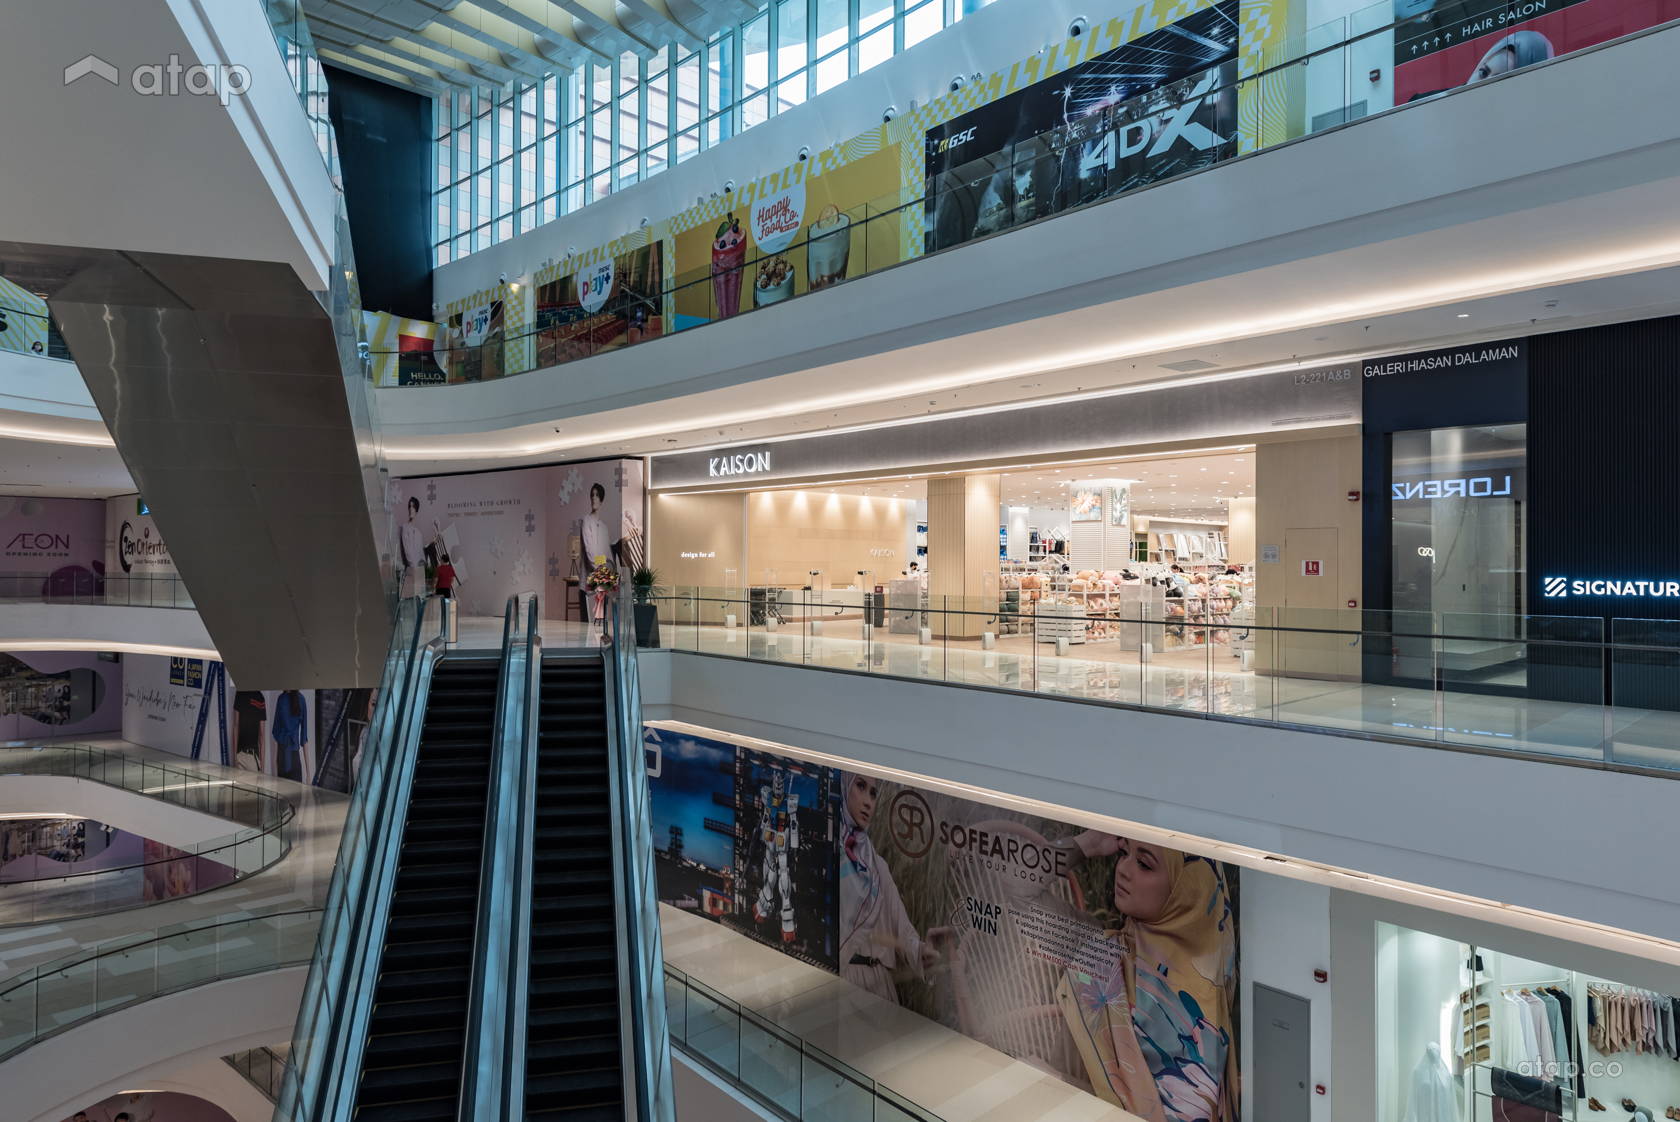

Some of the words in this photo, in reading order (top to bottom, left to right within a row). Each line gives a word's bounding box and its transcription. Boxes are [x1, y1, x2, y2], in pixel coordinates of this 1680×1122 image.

[1462, 18, 1493, 38] HAIR
[1498, 0, 1546, 25] SALON
[949, 126, 977, 149] GSC
[757, 195, 791, 227] Happy
[758, 215, 782, 240] Food
[1364, 362, 1406, 378] GALERI
[1408, 355, 1452, 374] HIASAN
[1455, 346, 1518, 367] DALAMAN
[1294, 369, 1351, 386] L2-221A&B
[709, 451, 771, 477] KAISON
[1572, 580, 1680, 597] SIGNATUR
[939, 821, 1067, 878] SOFEAROSE
[980, 858, 1007, 872] YOUR
[1014, 869, 1044, 883] LOOK
[967, 897, 1001, 920] SNAP
[1030, 906, 1042, 916] Snap
[971, 914, 997, 936] WIN
[1063, 961, 1078, 971] Cash
